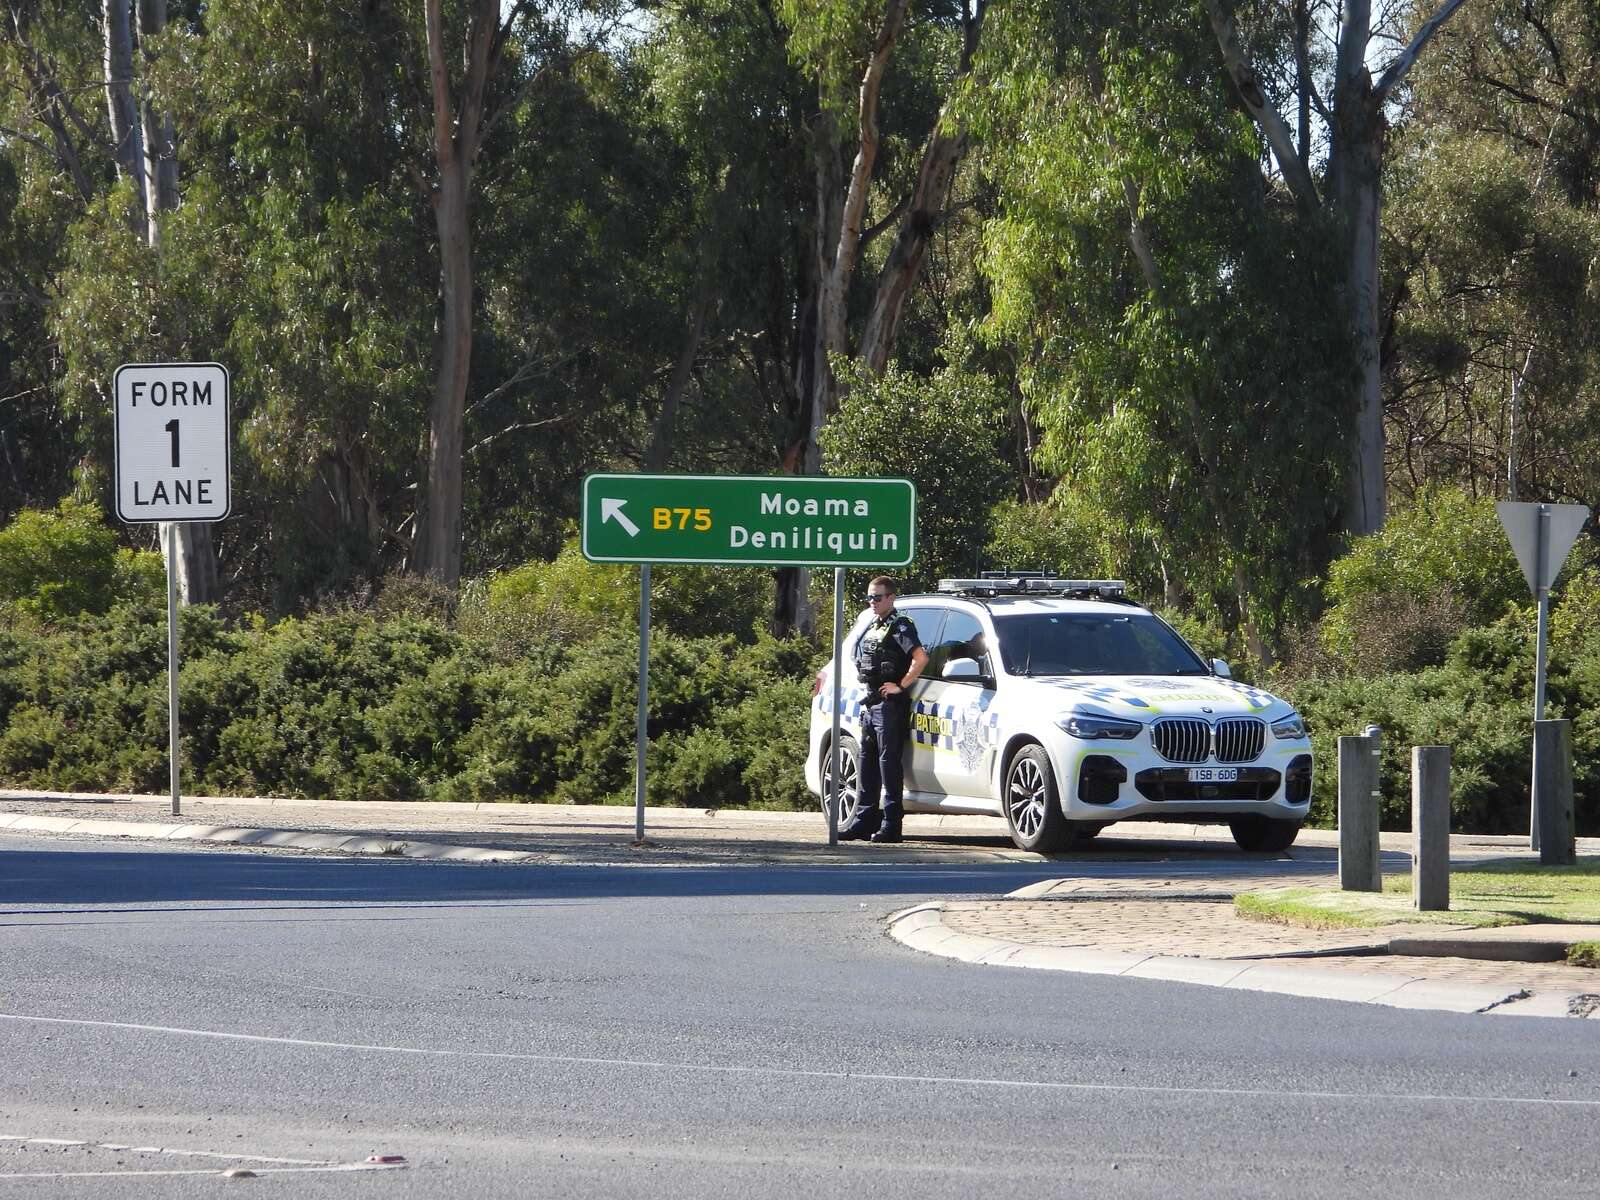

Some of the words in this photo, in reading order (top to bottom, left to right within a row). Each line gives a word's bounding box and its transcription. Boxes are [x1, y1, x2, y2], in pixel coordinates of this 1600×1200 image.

[131, 380, 212, 407] FORM
[165, 418, 180, 468] 1
[134, 479, 213, 506] LANE
[760, 492, 869, 517] Moama
[652, 507, 712, 531] B75
[729, 525, 898, 555] Deniliquin
